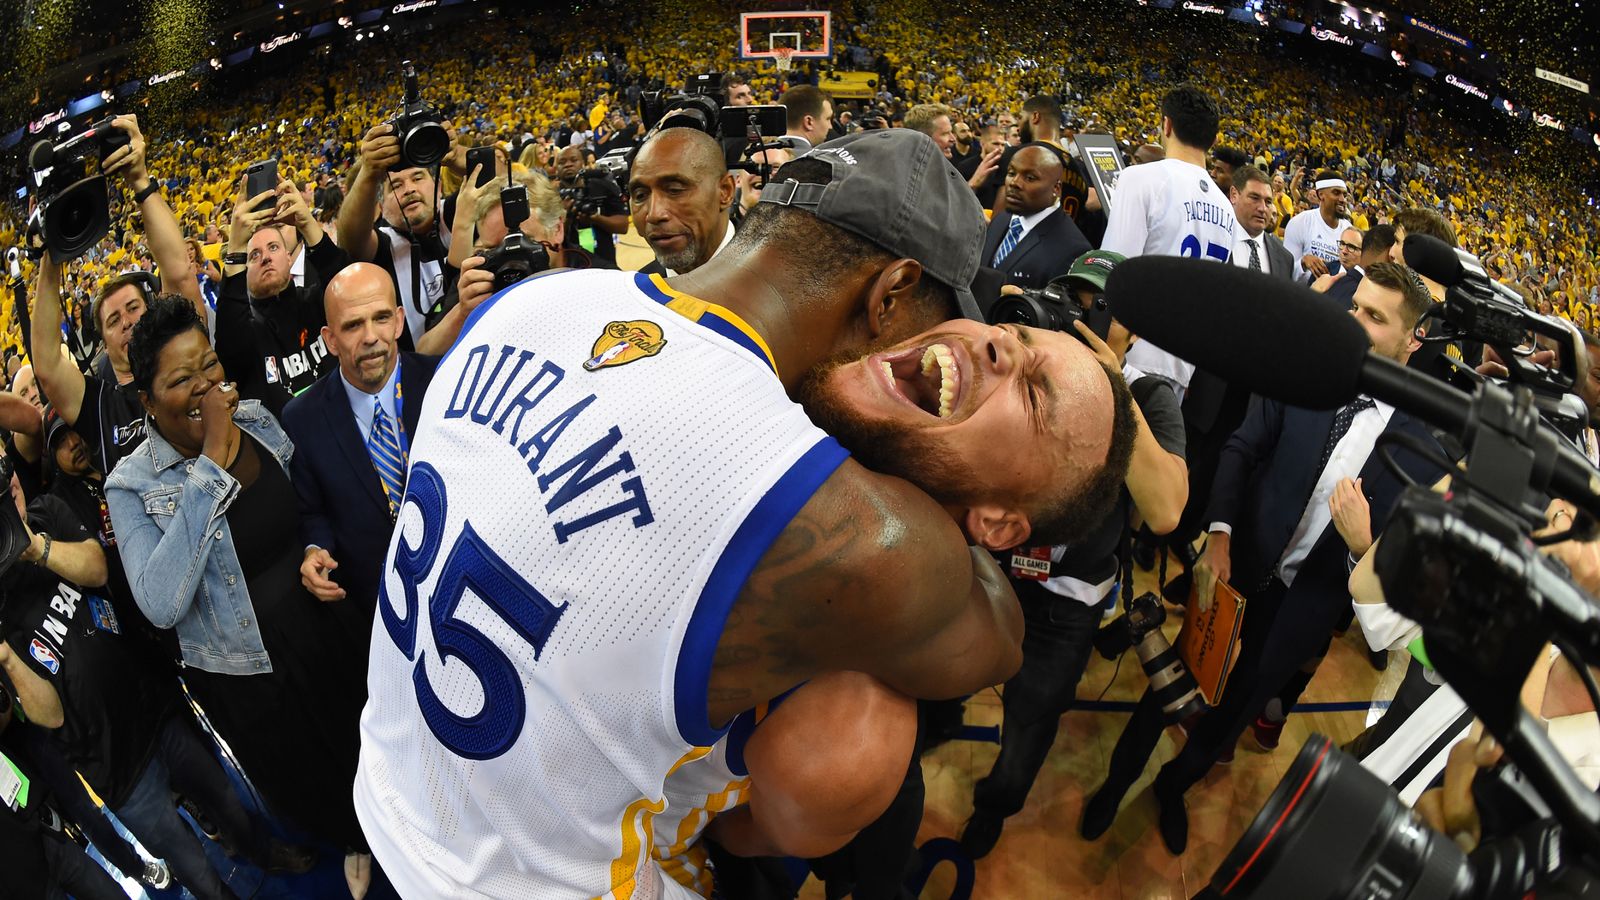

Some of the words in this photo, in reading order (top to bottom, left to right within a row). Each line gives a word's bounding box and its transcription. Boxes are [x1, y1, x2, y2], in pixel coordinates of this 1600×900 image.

[1417, 21, 1436, 32] GOLD
[1445, 74, 1488, 100] Champions
[282, 349, 312, 379] NBA
[443, 343, 656, 545] DURANT
[1014, 557, 1027, 568] ALL
[1026, 559, 1049, 571] GAMES
[378, 460, 570, 761] 35
